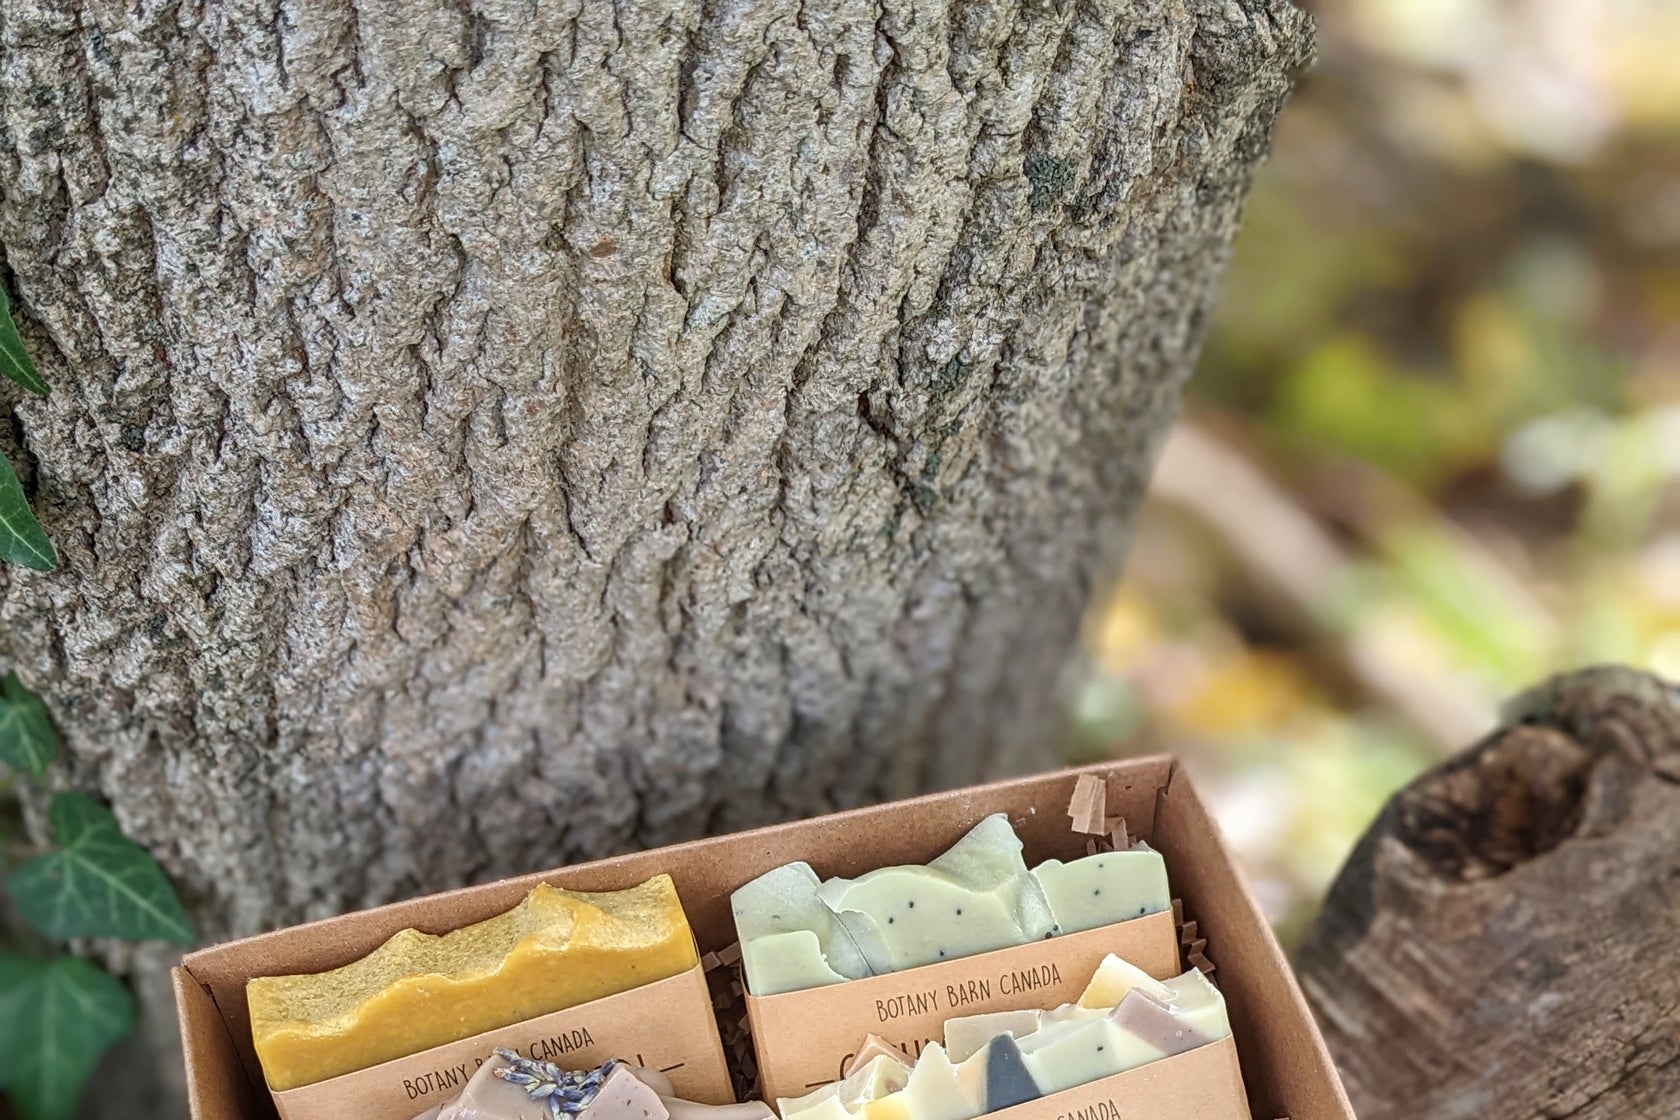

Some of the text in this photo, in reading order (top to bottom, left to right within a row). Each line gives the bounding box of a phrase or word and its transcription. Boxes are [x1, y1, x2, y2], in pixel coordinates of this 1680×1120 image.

[875, 962, 1063, 1023] BOTANY BARN CANADA
[402, 1063, 470, 1100] BOTANY
[527, 1026, 595, 1065] CANADA
